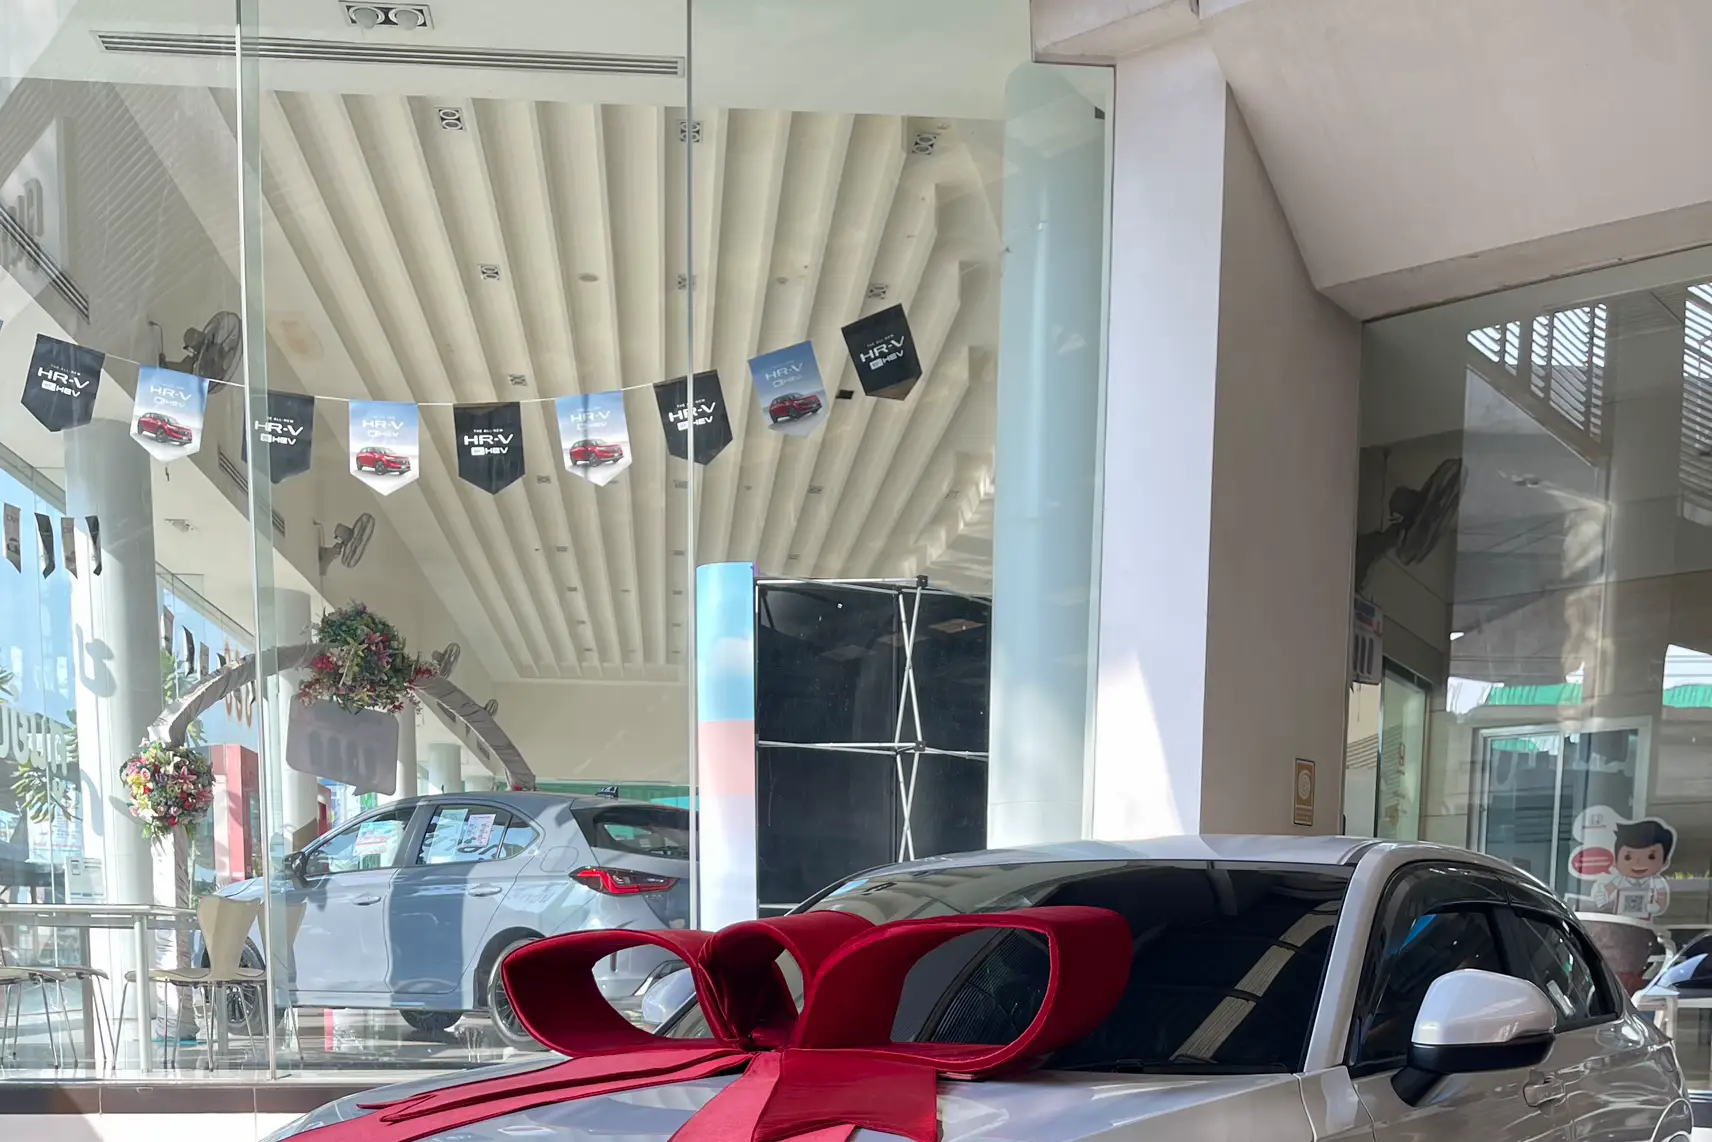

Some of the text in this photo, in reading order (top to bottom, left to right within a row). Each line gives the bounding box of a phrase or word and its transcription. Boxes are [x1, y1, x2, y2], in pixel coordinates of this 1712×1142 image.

[860, 335, 905, 363] HR-V
[37, 366, 90, 389] HR-V
[765, 361, 803, 380] HR-V
[149, 384, 193, 401] HR-V
[570, 410, 611, 423] HR-V
[668, 402, 716, 422] HR-V
[254, 420, 304, 436] HR-V
[362, 419, 404, 430] HR-V
[463, 433, 514, 446] HR-V
